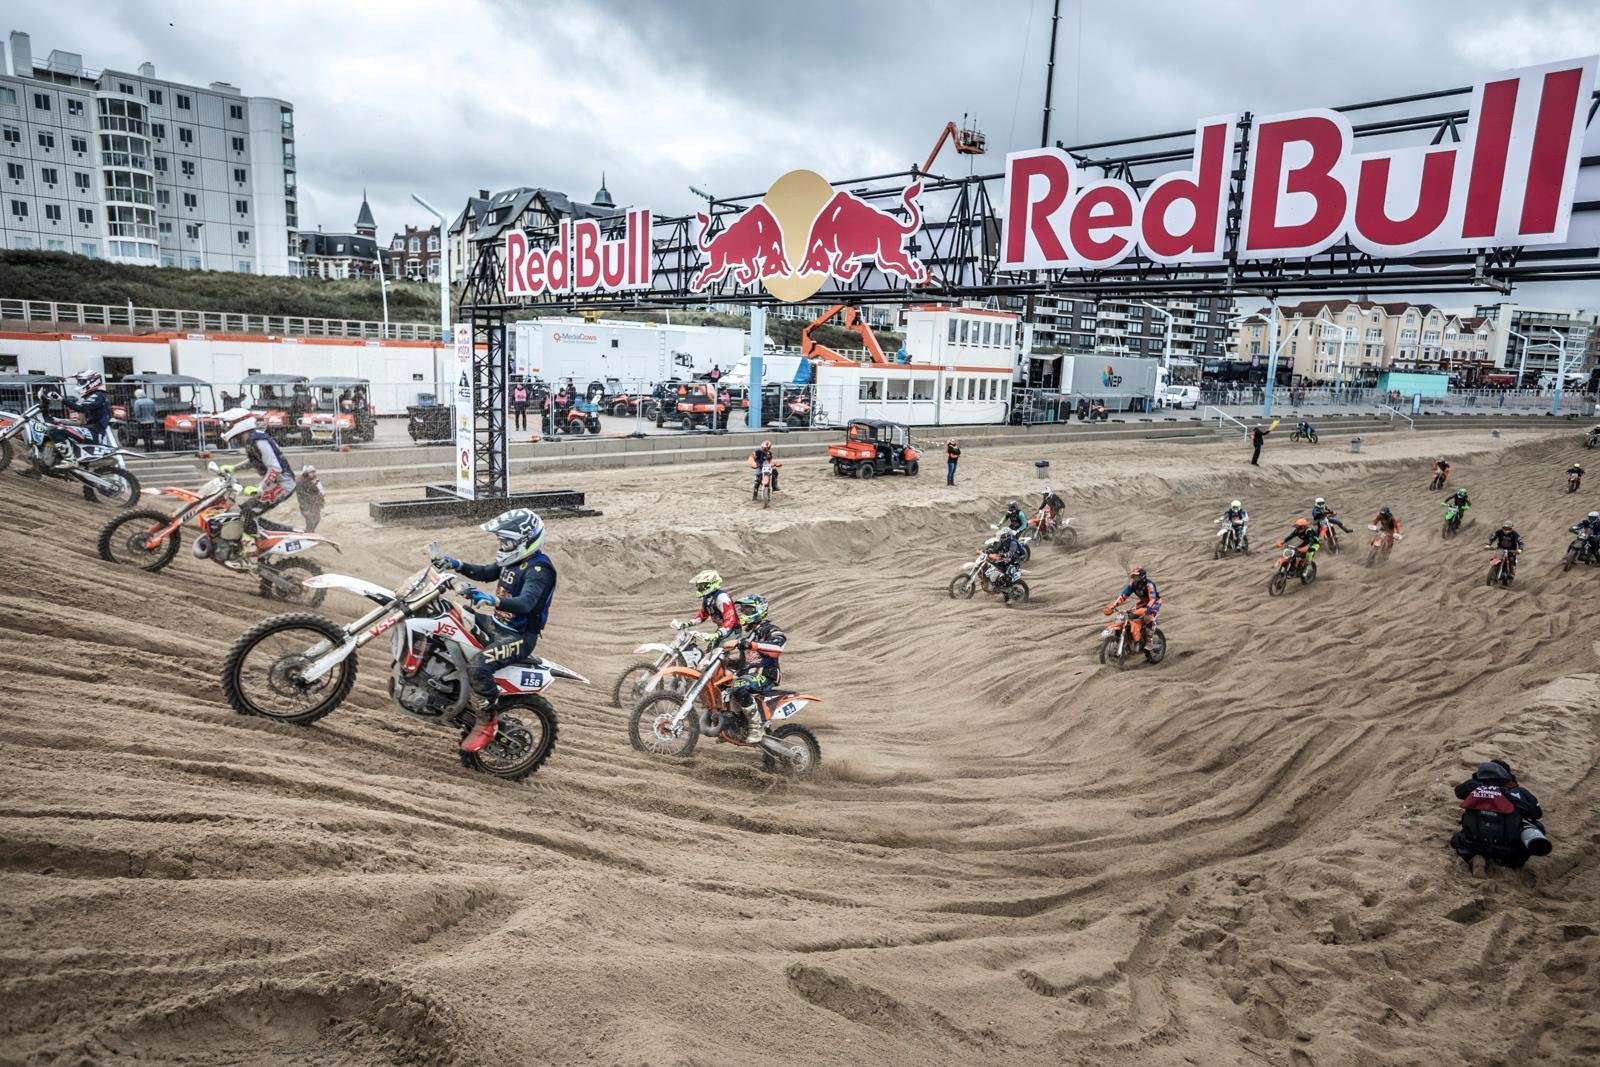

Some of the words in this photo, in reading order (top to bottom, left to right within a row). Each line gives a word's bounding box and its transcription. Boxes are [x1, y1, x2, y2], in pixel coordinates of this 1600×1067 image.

[1106, 376, 1123, 387] NEP
[368, 616, 398, 638] YSS
[434, 621, 458, 637] YSS
[483, 640, 524, 664] SHIFT
[523, 678, 541, 687] 156
